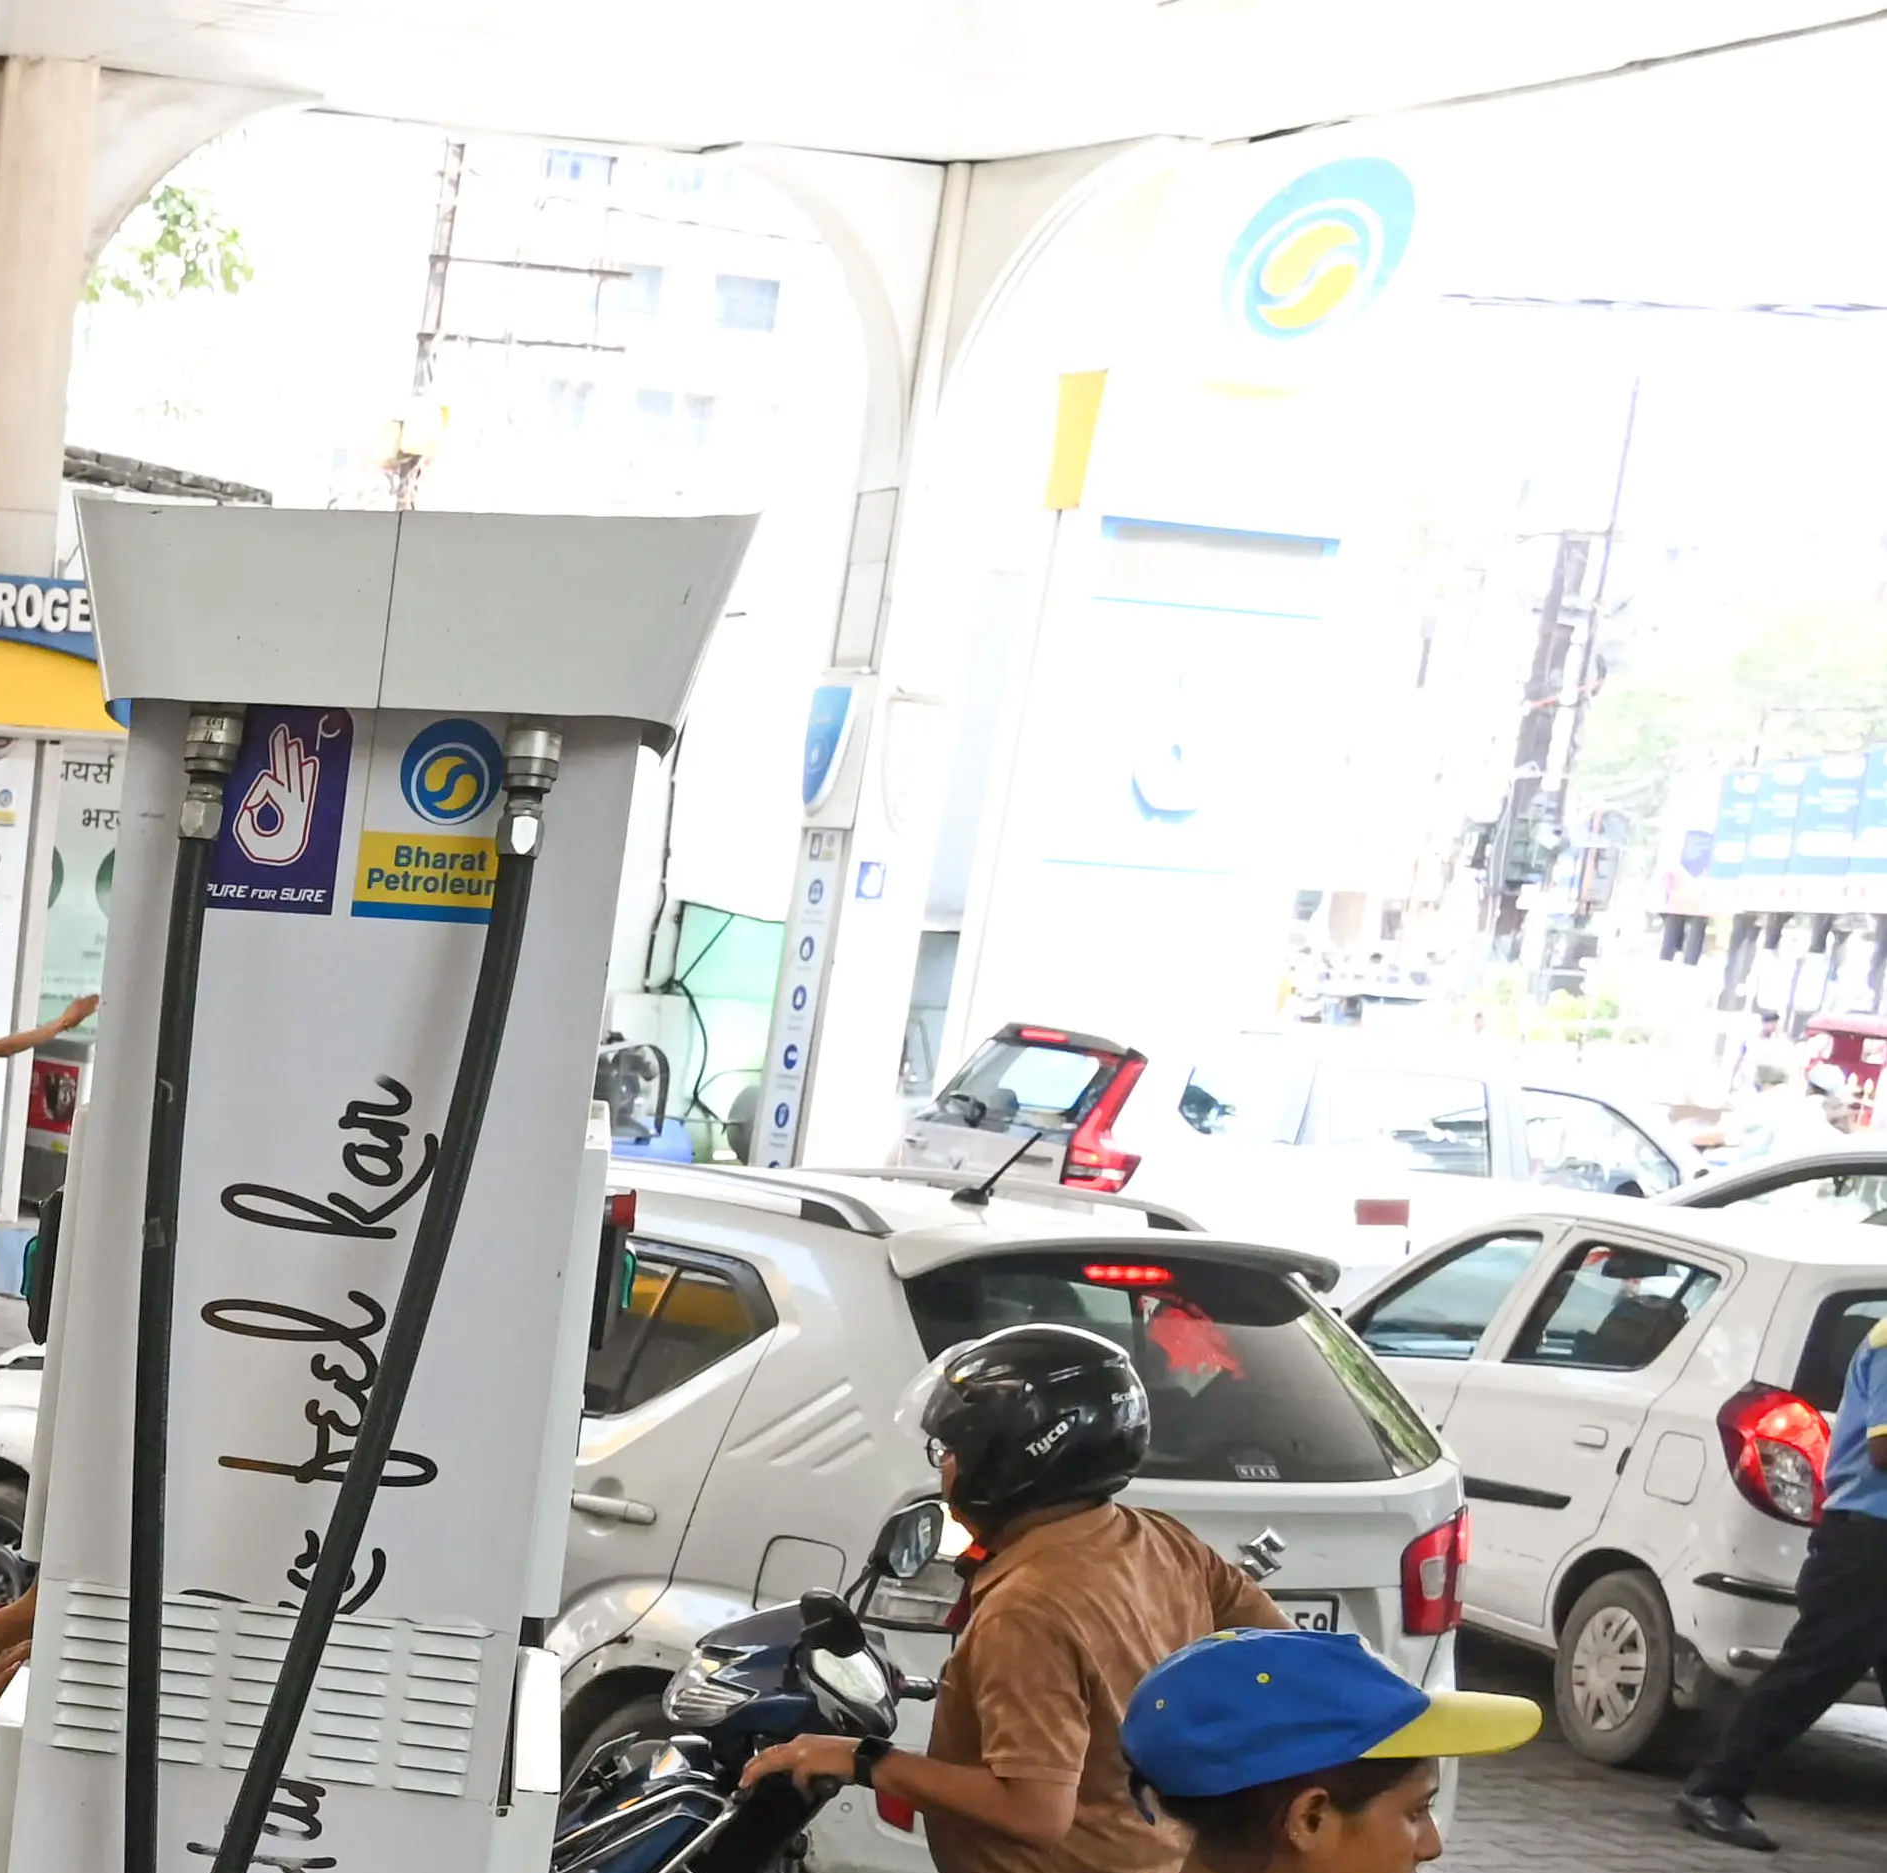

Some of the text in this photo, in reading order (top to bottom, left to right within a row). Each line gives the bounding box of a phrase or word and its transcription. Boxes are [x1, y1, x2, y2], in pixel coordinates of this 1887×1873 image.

[61, 755, 115, 785] ायर्स
[394, 845, 487, 872] Bharat
[250, 888, 278, 901] FOR
[279, 887, 327, 903] SURE
[220, 1072, 440, 1239] kar
[201, 1289, 439, 1487] feel
[1025, 1420, 1069, 1458] Tyco
